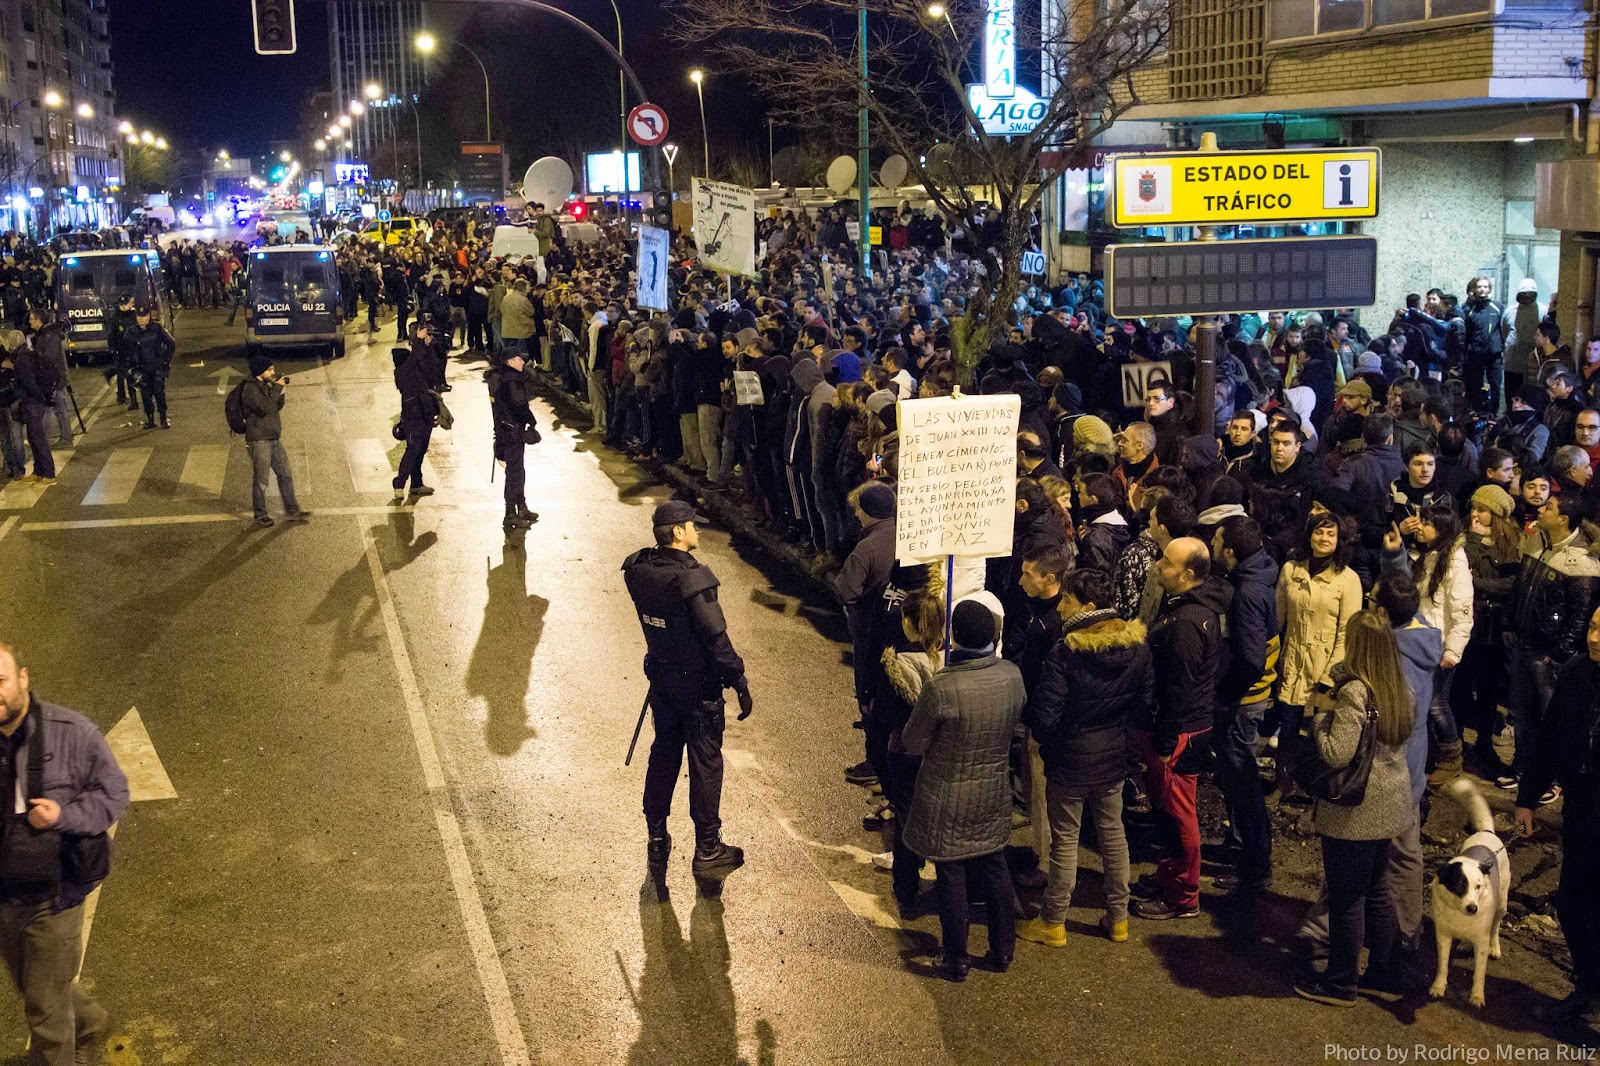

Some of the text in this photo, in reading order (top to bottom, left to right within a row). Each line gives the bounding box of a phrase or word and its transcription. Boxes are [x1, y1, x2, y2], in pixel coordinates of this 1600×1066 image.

[991, 0, 1011, 85] ERIA
[974, 102, 1047, 125] LAGO
[1184, 163, 1310, 183] ESTADO DEL
[1203, 190, 1292, 211] TRÁFICO
[1024, 253, 1044, 273] NO
[68, 308, 104, 318] POLICIA
[257, 303, 291, 312] POLICIA
[315, 303, 326, 311] 22
[913, 409, 1014, 428] LAS VIVIENDAS
[905, 426, 1011, 446] DE JUAN XXIII NO
[988, 456, 1015, 470] PONE
[899, 475, 1003, 495] EN SERIO PELIGRO
[899, 510, 915, 519] EL
[899, 521, 915, 532] LE
[920, 517, 934, 527] DA
[954, 519, 991, 531] VIVIR
[908, 531, 987, 552] EN PAZ
